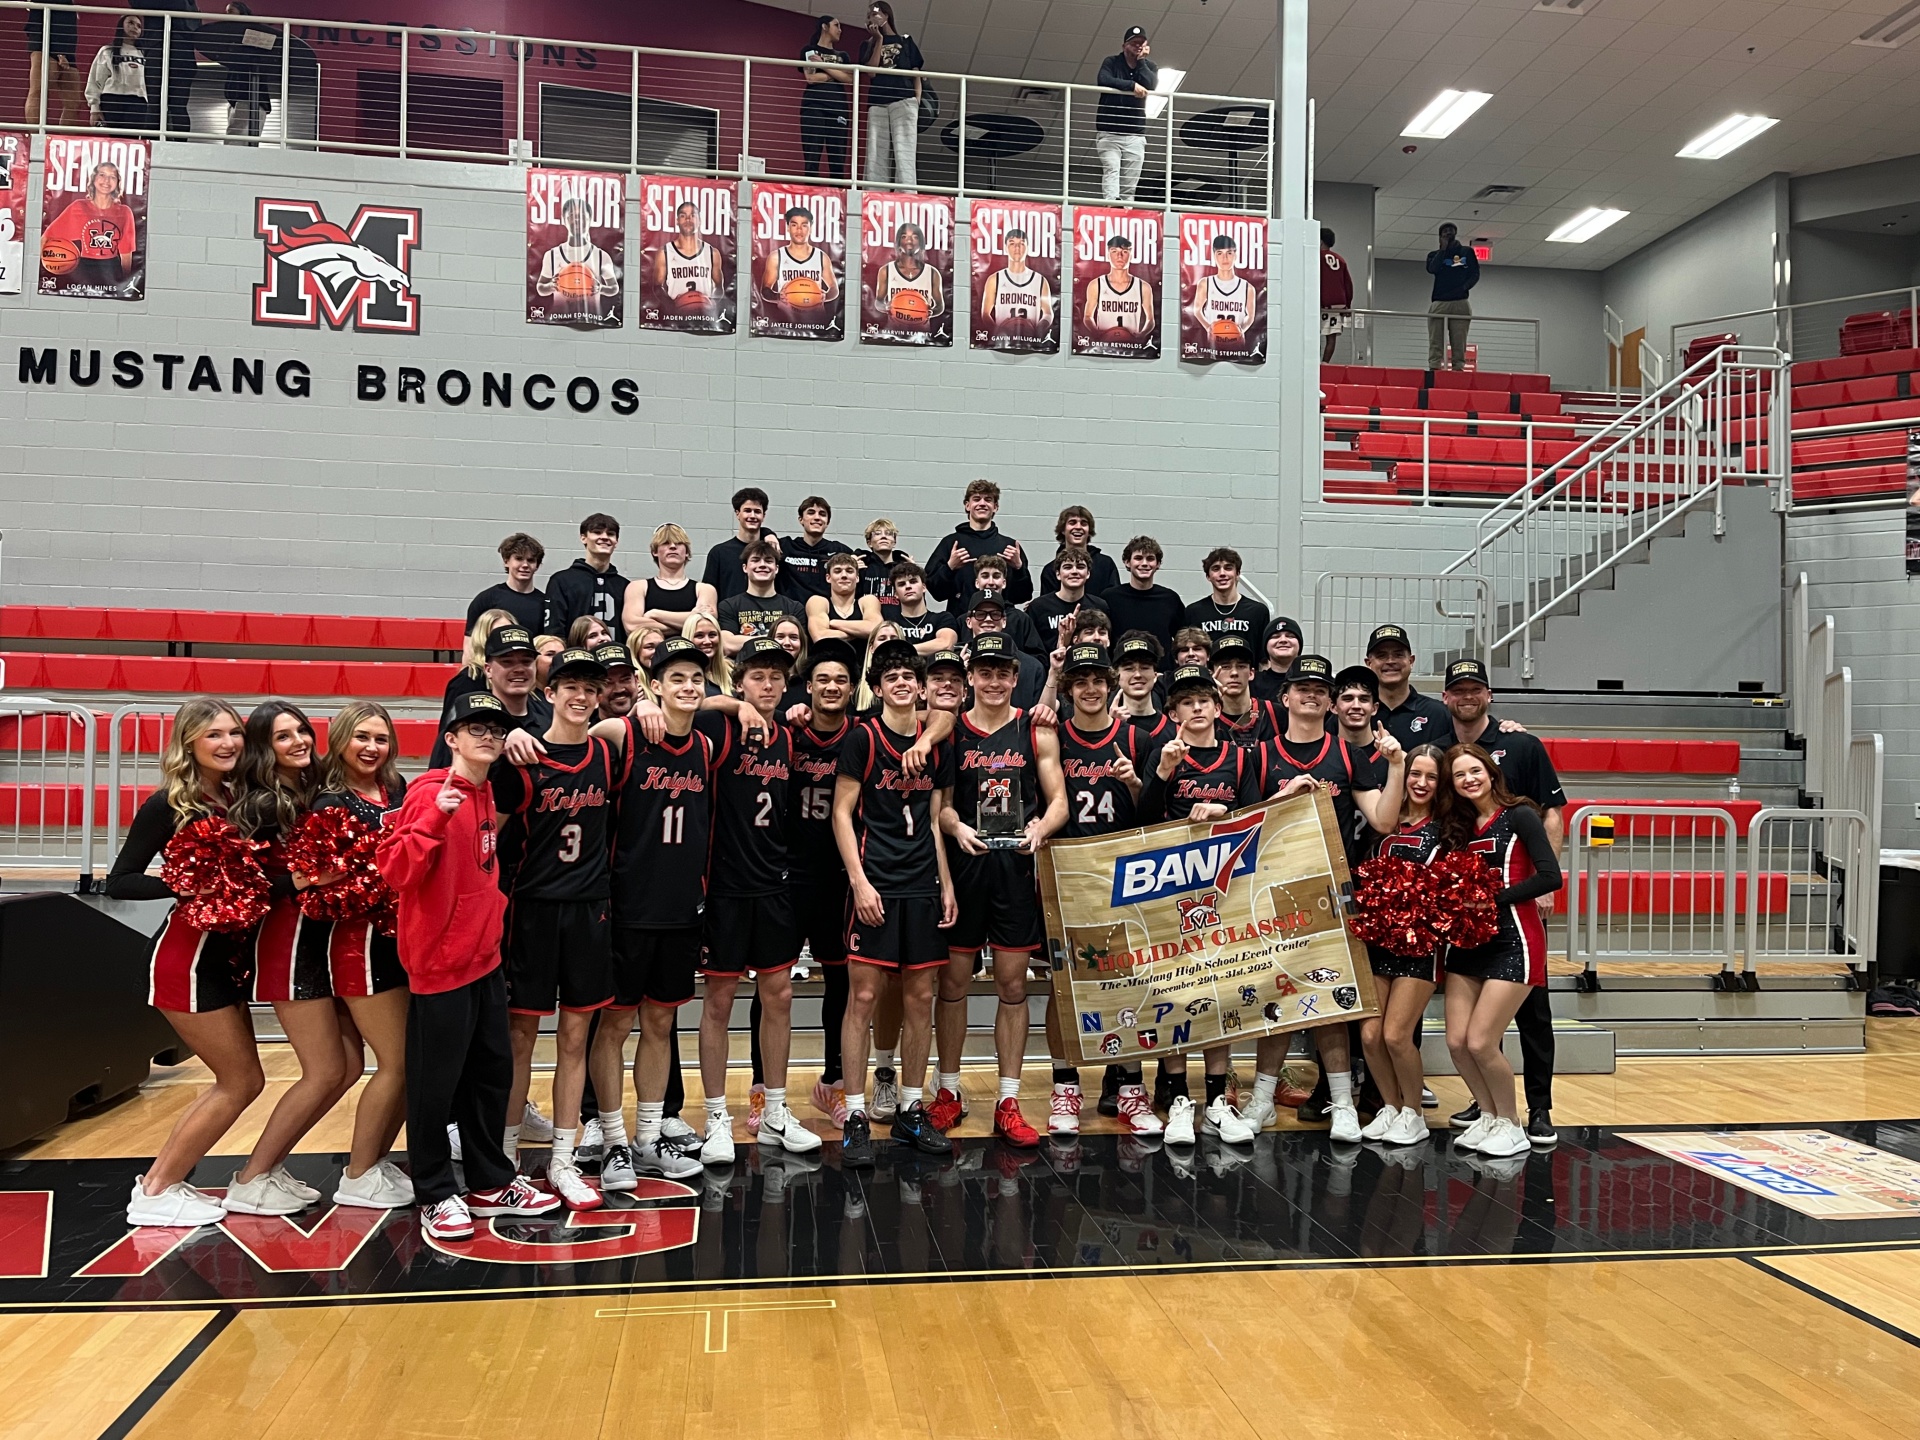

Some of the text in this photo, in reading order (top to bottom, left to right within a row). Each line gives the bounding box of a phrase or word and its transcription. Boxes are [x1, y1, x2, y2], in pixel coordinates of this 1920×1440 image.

[47, 139, 146, 195] SENIOR
[530, 173, 621, 229] SENIOR
[647, 184, 731, 236] SENIOR
[757, 192, 841, 243] SENIOR
[867, 200, 949, 251] SENIOR
[976, 208, 1056, 258] SENIOR
[1079, 214, 1158, 265] SENIOR
[1183, 219, 1263, 270] SENIOR
[671, 267, 709, 279] BRONCOS
[1325, 254, 1340, 270] OU
[1000, 293, 1037, 306] BRONCOS
[1101, 300, 1139, 313] BRONCOS
[1211, 299, 1242, 313] BRONCOS
[573, 312, 603, 321] EDMOND
[684, 314, 715, 322] JOHNSON
[1012, 335, 1042, 343] MILLIGAN
[1219, 349, 1249, 357] STEPHENS
[18, 346, 641, 416] MUSTANG BRONCOS
[984, 588, 992, 599] B
[733, 753, 790, 786] Knights
[960, 748, 1027, 774] Knights
[640, 766, 704, 799] Knights
[875, 768, 934, 798] Knights
[1174, 779, 1236, 803] Knights
[535, 784, 606, 817] Knights
[754, 791, 773, 827] 2
[800, 786, 832, 820] 15
[1076, 790, 1116, 824] 24
[662, 805, 685, 844] 11
[902, 804, 913, 836] 1
[558, 824, 582, 862] 3
[1121, 841, 1247, 898] BANK
[850, 933, 861, 951] C
[1097, 908, 1314, 972] HOLIDAY CLASSIC
[1100, 938, 1310, 991] The Mustang High School Event Center
[1152, 979, 1196, 997] December
[1197, 973, 1219, 986] 29th
[1247, 960, 1273, 974] 2025
[1080, 1011, 1104, 1034] N
[1152, 1002, 1174, 1024] P
